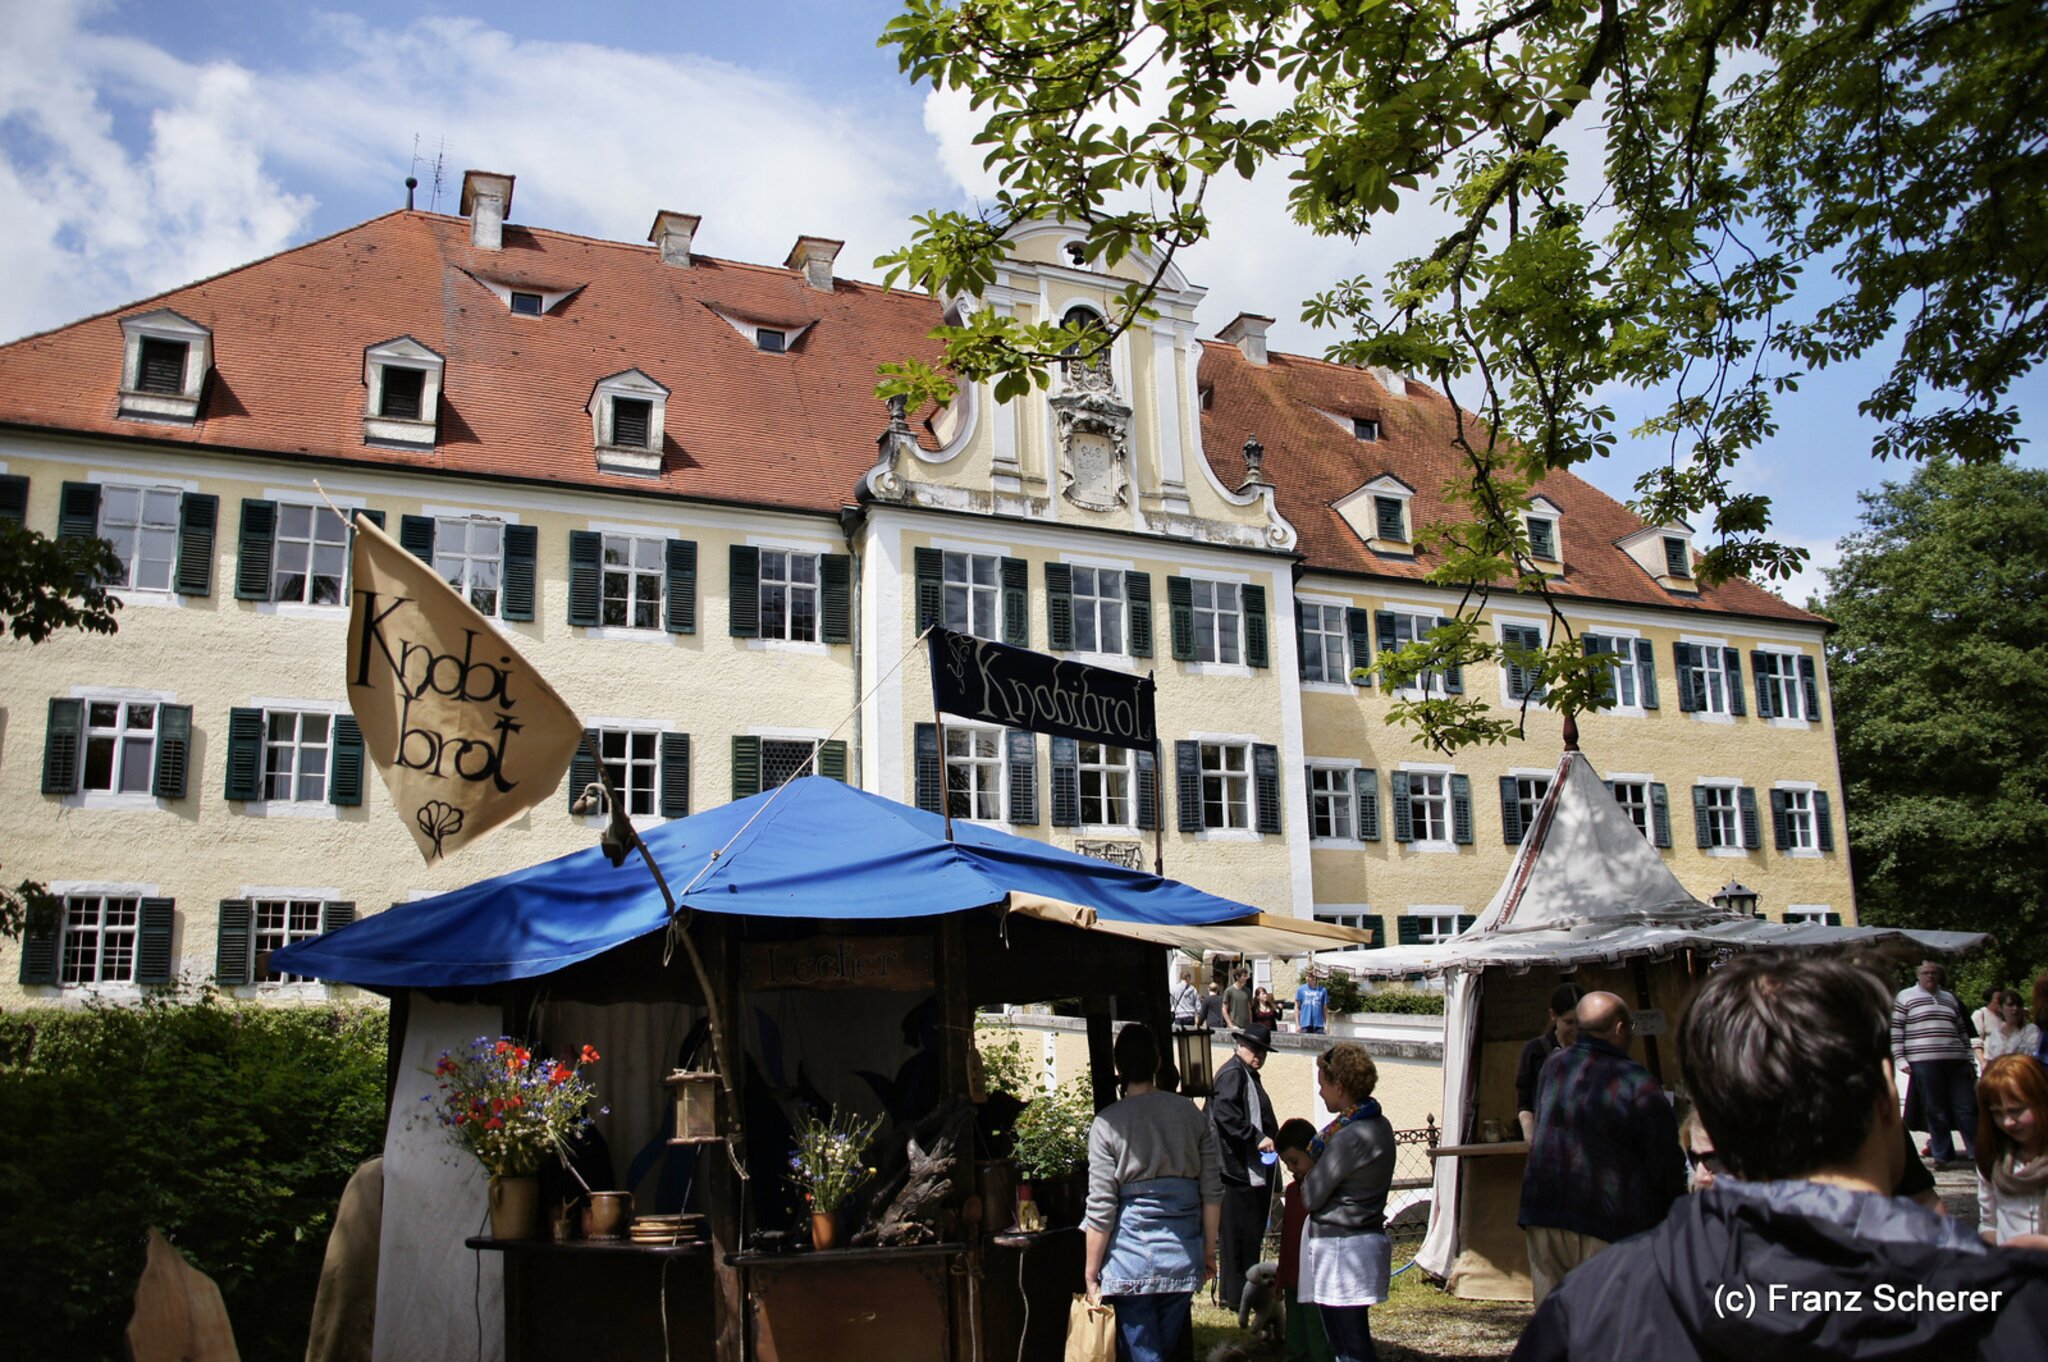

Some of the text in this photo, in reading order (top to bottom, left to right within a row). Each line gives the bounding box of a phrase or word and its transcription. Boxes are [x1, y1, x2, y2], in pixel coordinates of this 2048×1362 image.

[351, 589, 517, 710] Knobi
[974, 638, 1151, 741] Knobibrot
[393, 694, 525, 793] brot
